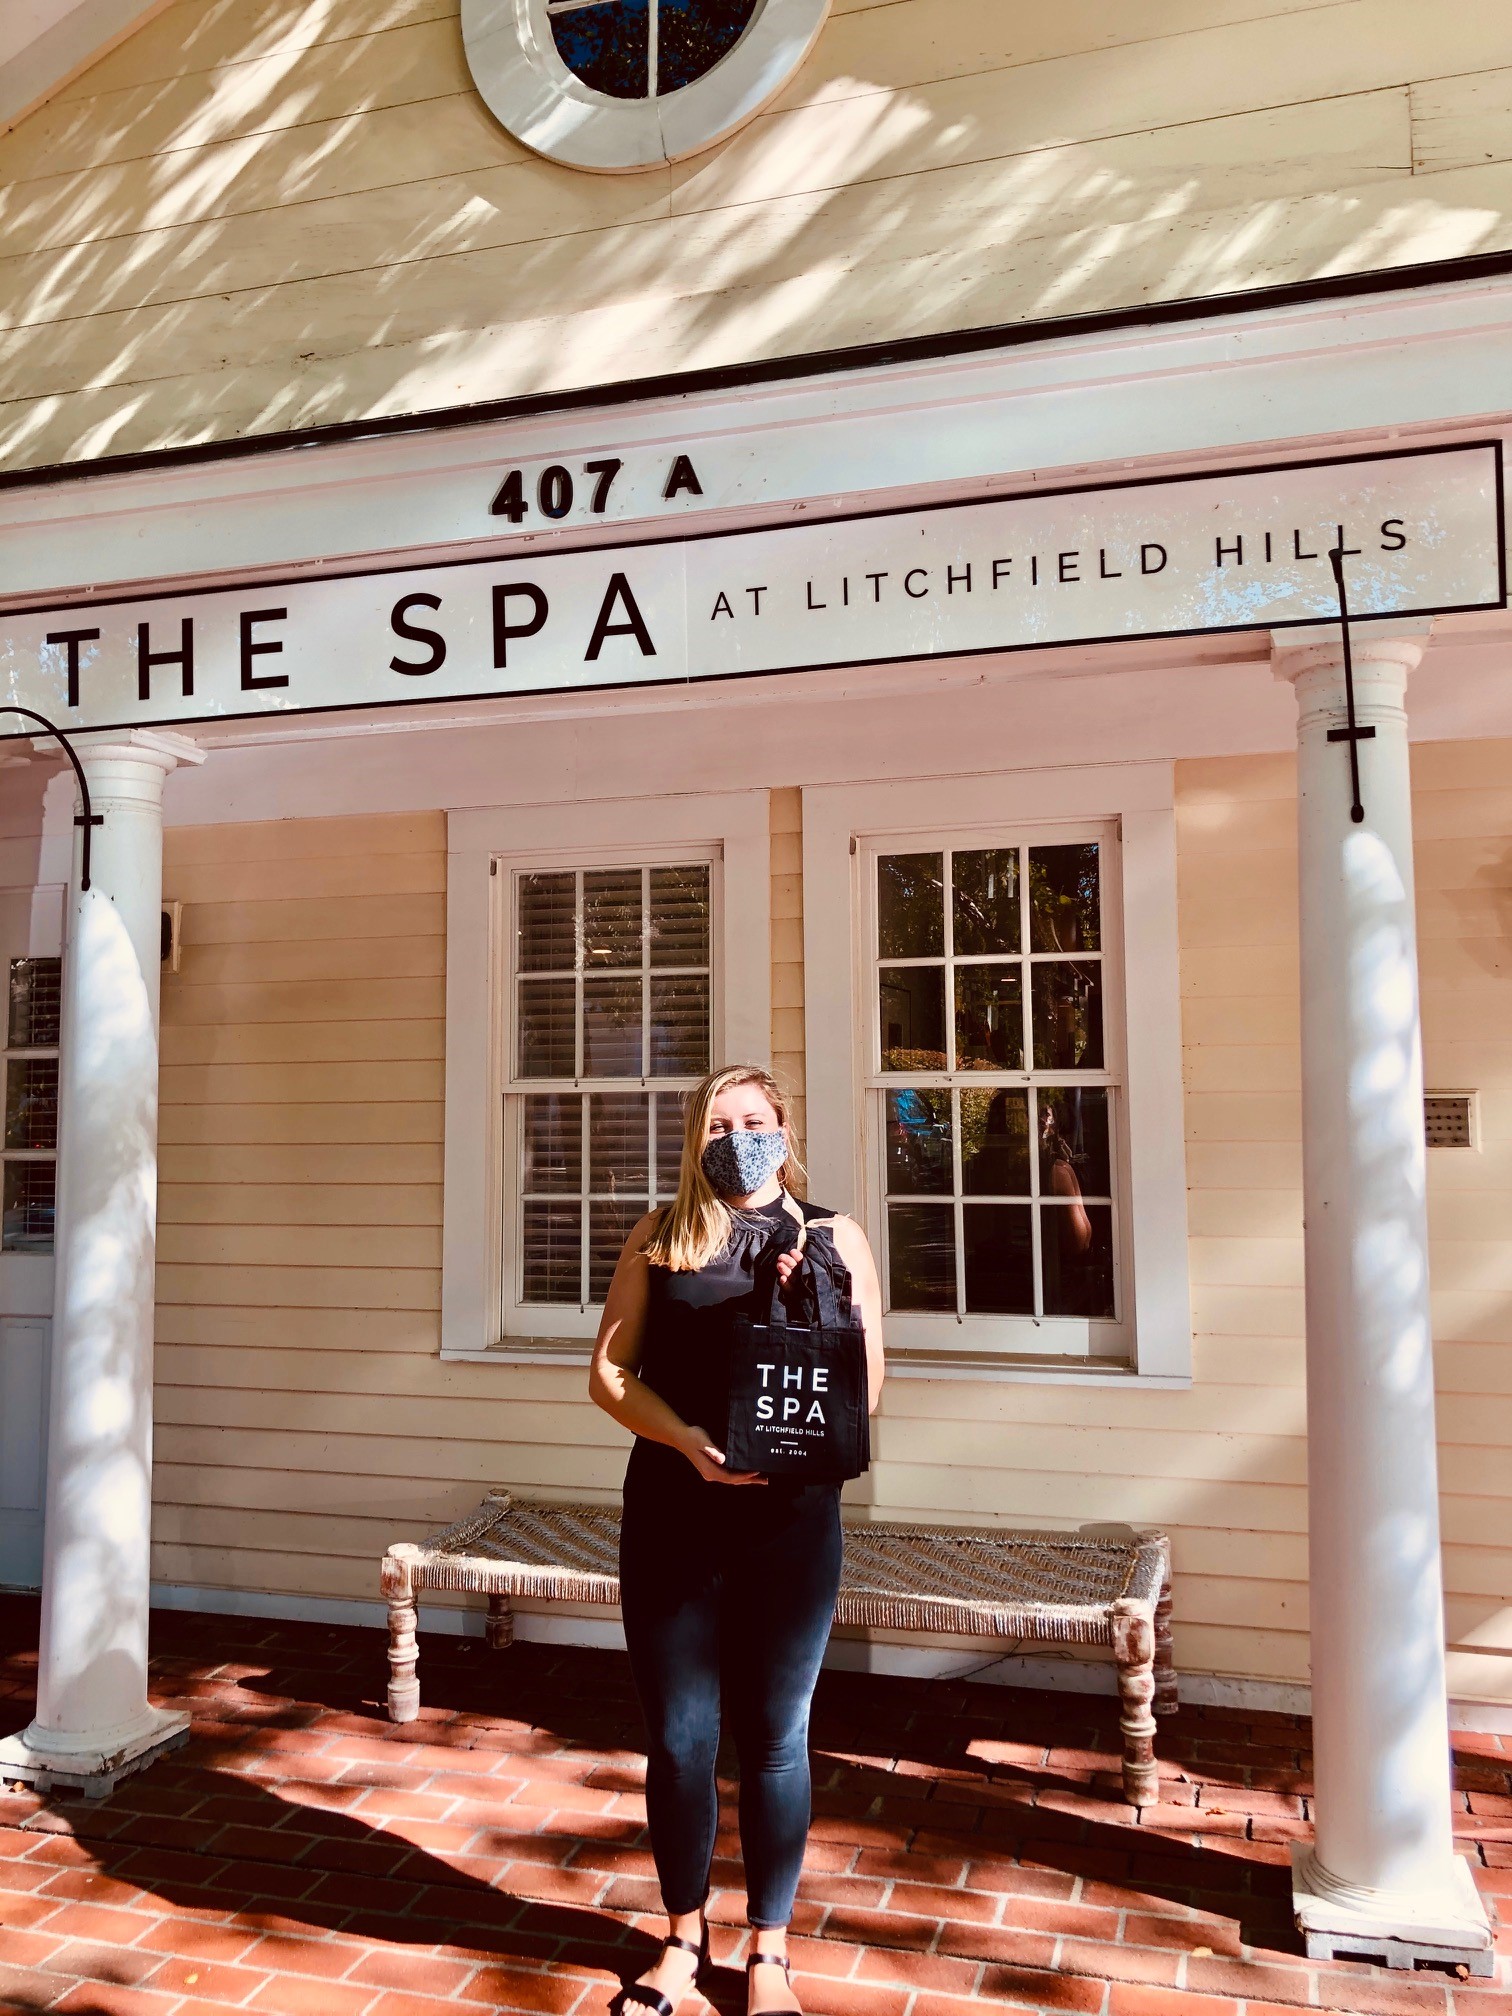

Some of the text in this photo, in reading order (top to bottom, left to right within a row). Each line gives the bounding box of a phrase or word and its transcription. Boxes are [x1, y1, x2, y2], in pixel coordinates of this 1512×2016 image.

[490, 454, 704, 524] 407 A
[46, 518, 1407, 707] THE SPA AT LITCHFIELD HILLS
[756, 1363, 829, 1392] THE
[756, 1395, 826, 1424] SPA
[755, 1424, 825, 1437] AT LITCHFIELD HILLS
[788, 1448, 807, 1456] 2004
